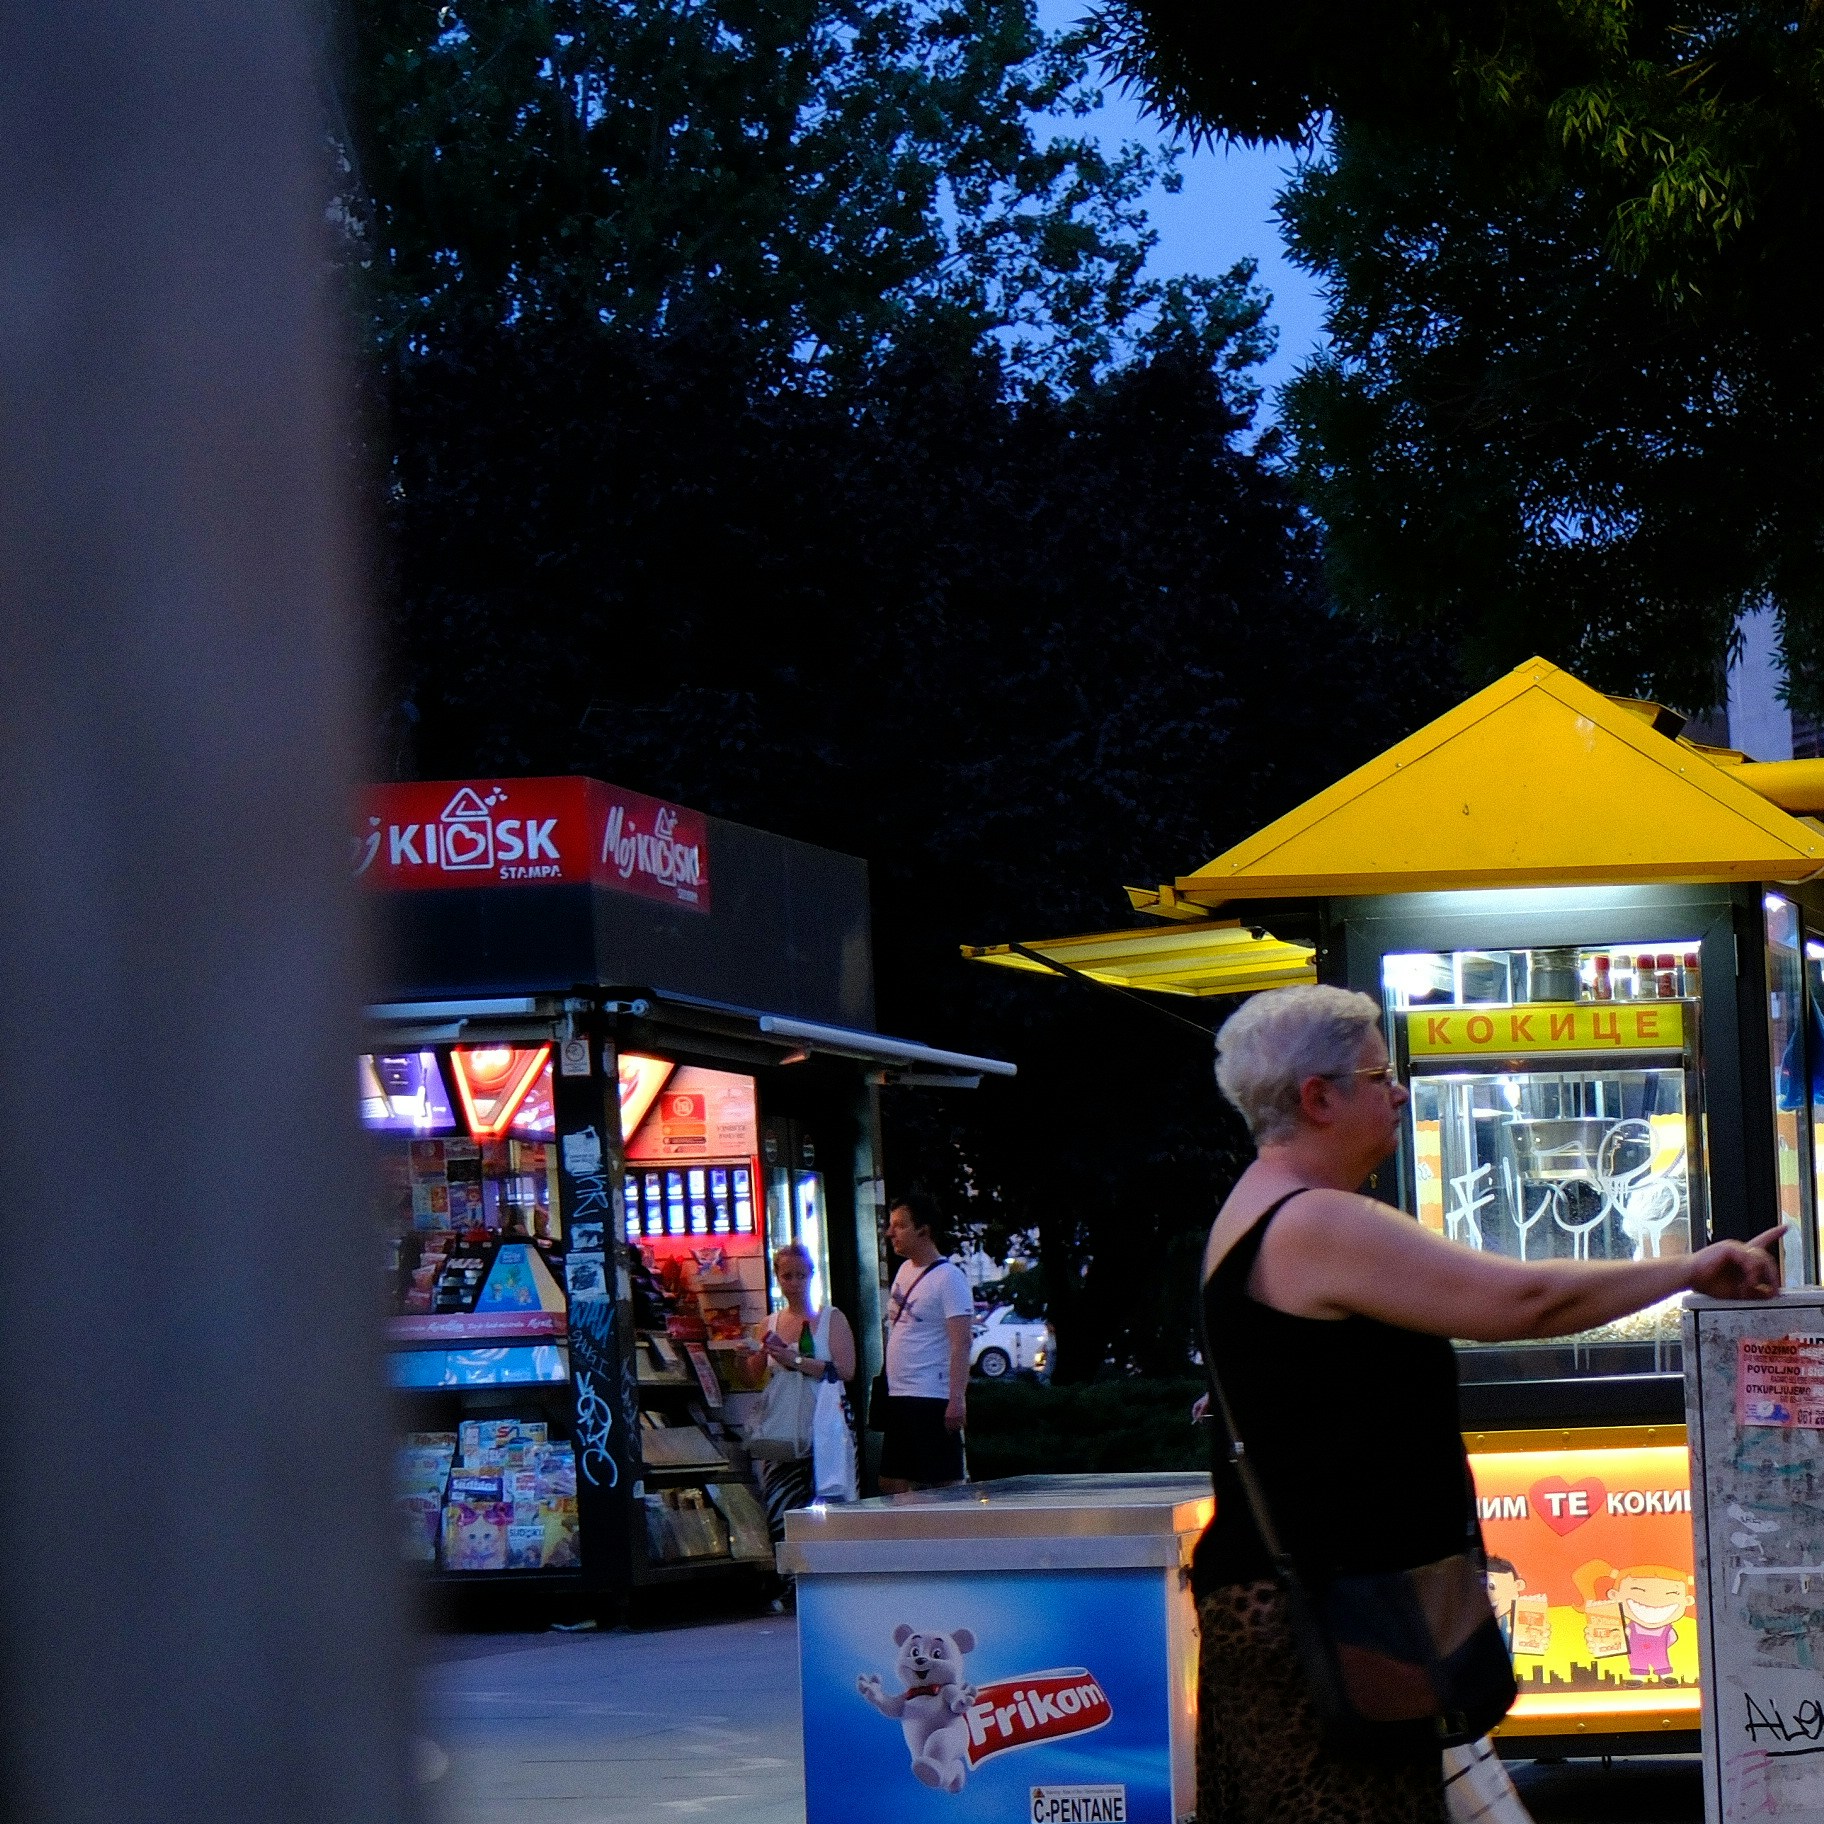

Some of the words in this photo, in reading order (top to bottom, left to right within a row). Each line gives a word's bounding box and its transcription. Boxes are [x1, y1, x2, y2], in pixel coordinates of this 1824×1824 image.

[389, 818, 560, 870] KIOSK
[1429, 1010, 1660, 1046] КОКИЦЕ
[1744, 1345, 1797, 1354] ODVOZIMO
[1747, 1365, 1801, 1376] POVOLJNO
[1746, 1385, 1812, 1395] OTKUPLJUJEMO
[1544, 1490, 1588, 1516] ТЕ
[968, 1684, 1105, 1746] Frikom
[1034, 1798, 1123, 1823] C-PENTANE
